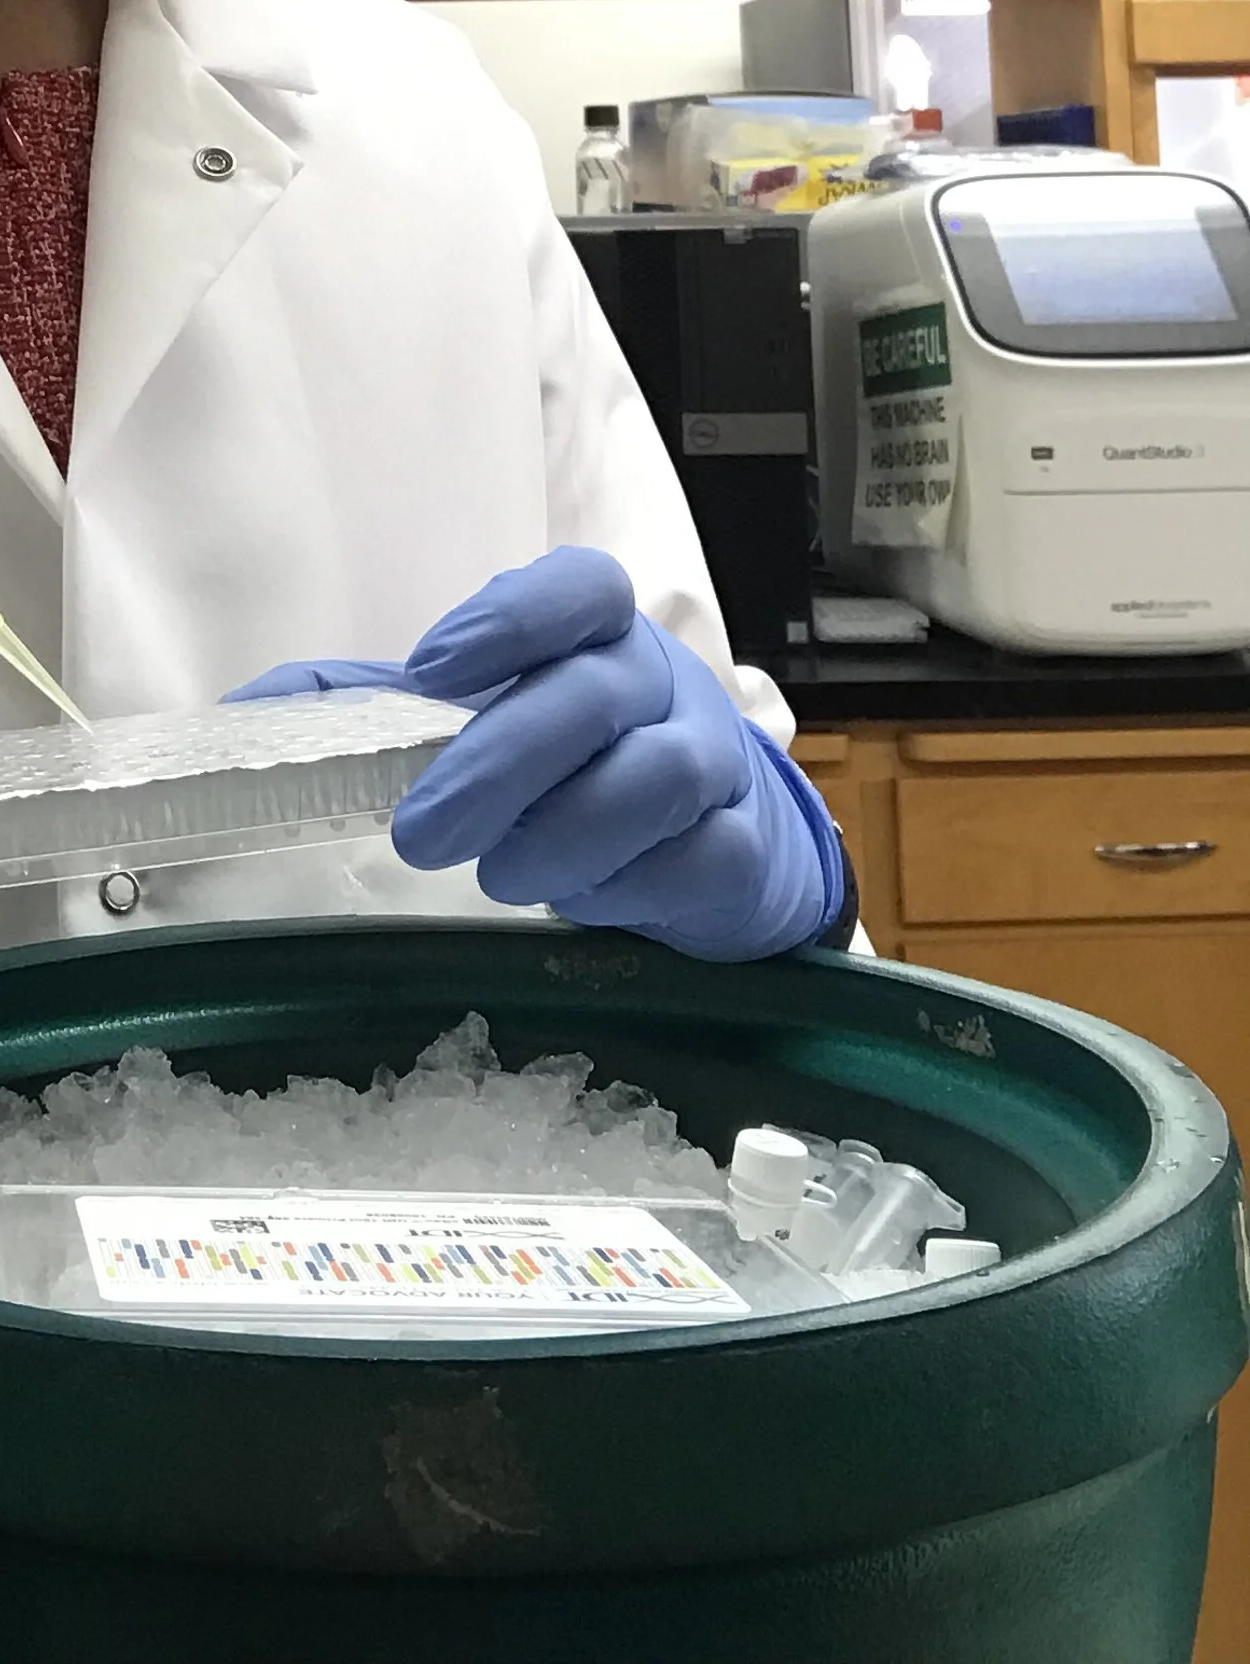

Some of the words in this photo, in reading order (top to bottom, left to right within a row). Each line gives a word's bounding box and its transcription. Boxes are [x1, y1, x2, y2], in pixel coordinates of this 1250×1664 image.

[893, 396, 946, 427] MACHINE
[870, 442, 895, 470] HAS
[913, 437, 950, 466] BRAIN
[865, 482, 892, 508] USE
[893, 480, 927, 508] YOUR
[297, 1288, 447, 1298] ADVOCATE
[458, 1291, 535, 1299] YOUR
